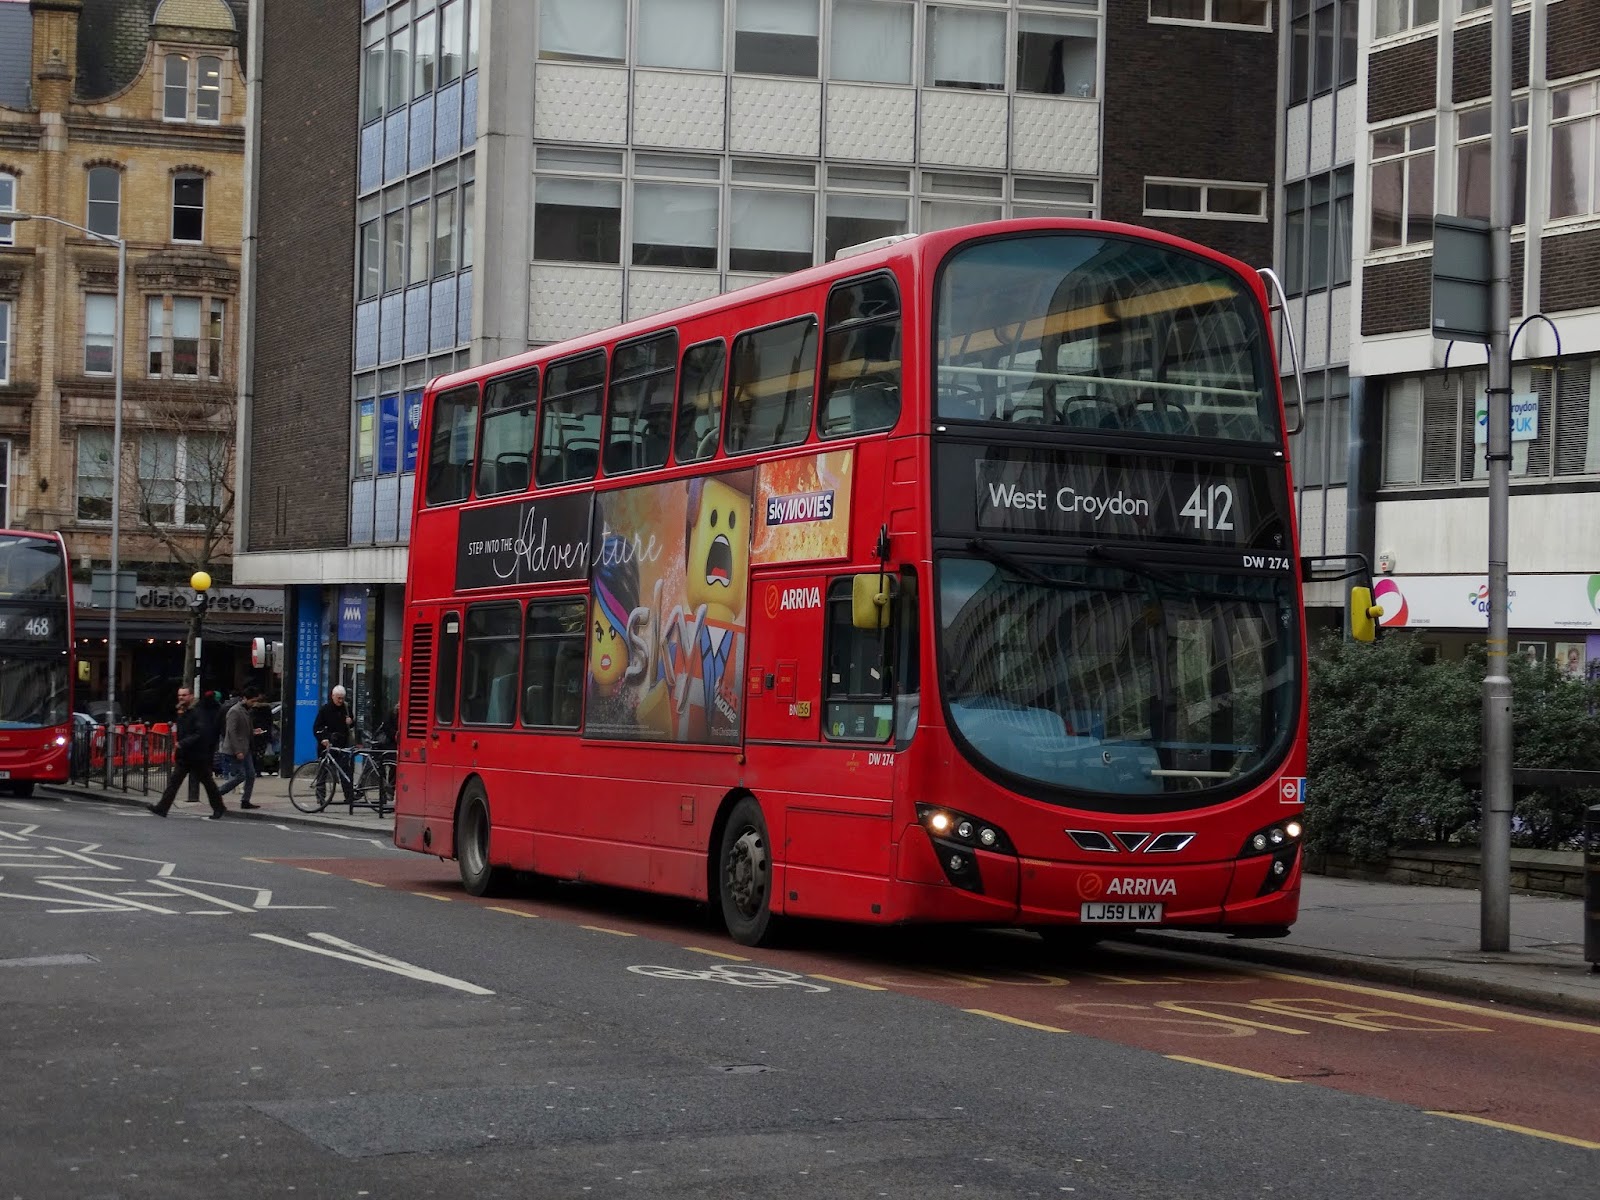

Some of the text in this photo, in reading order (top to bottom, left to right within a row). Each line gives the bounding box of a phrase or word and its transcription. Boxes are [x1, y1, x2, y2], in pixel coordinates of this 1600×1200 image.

[1511, 400, 1537, 416] roydon
[1516, 417, 1532, 432] UK
[988, 483, 1234, 531] West Croydon 412
[468, 506, 663, 579] STEP INTO THE Adventure
[1243, 555, 1290, 571] DW 274
[135, 590, 255, 611] dizio reto
[780, 587, 821, 611] ARRIVA
[24, 617, 49, 636] 468
[714, 696, 737, 724] MOVIE
[868, 752, 880, 766] DW
[882, 753, 894, 767] 274
[1106, 877, 1177, 896] ARRIVA
[1087, 905, 1156, 920] LJ59 LWX
